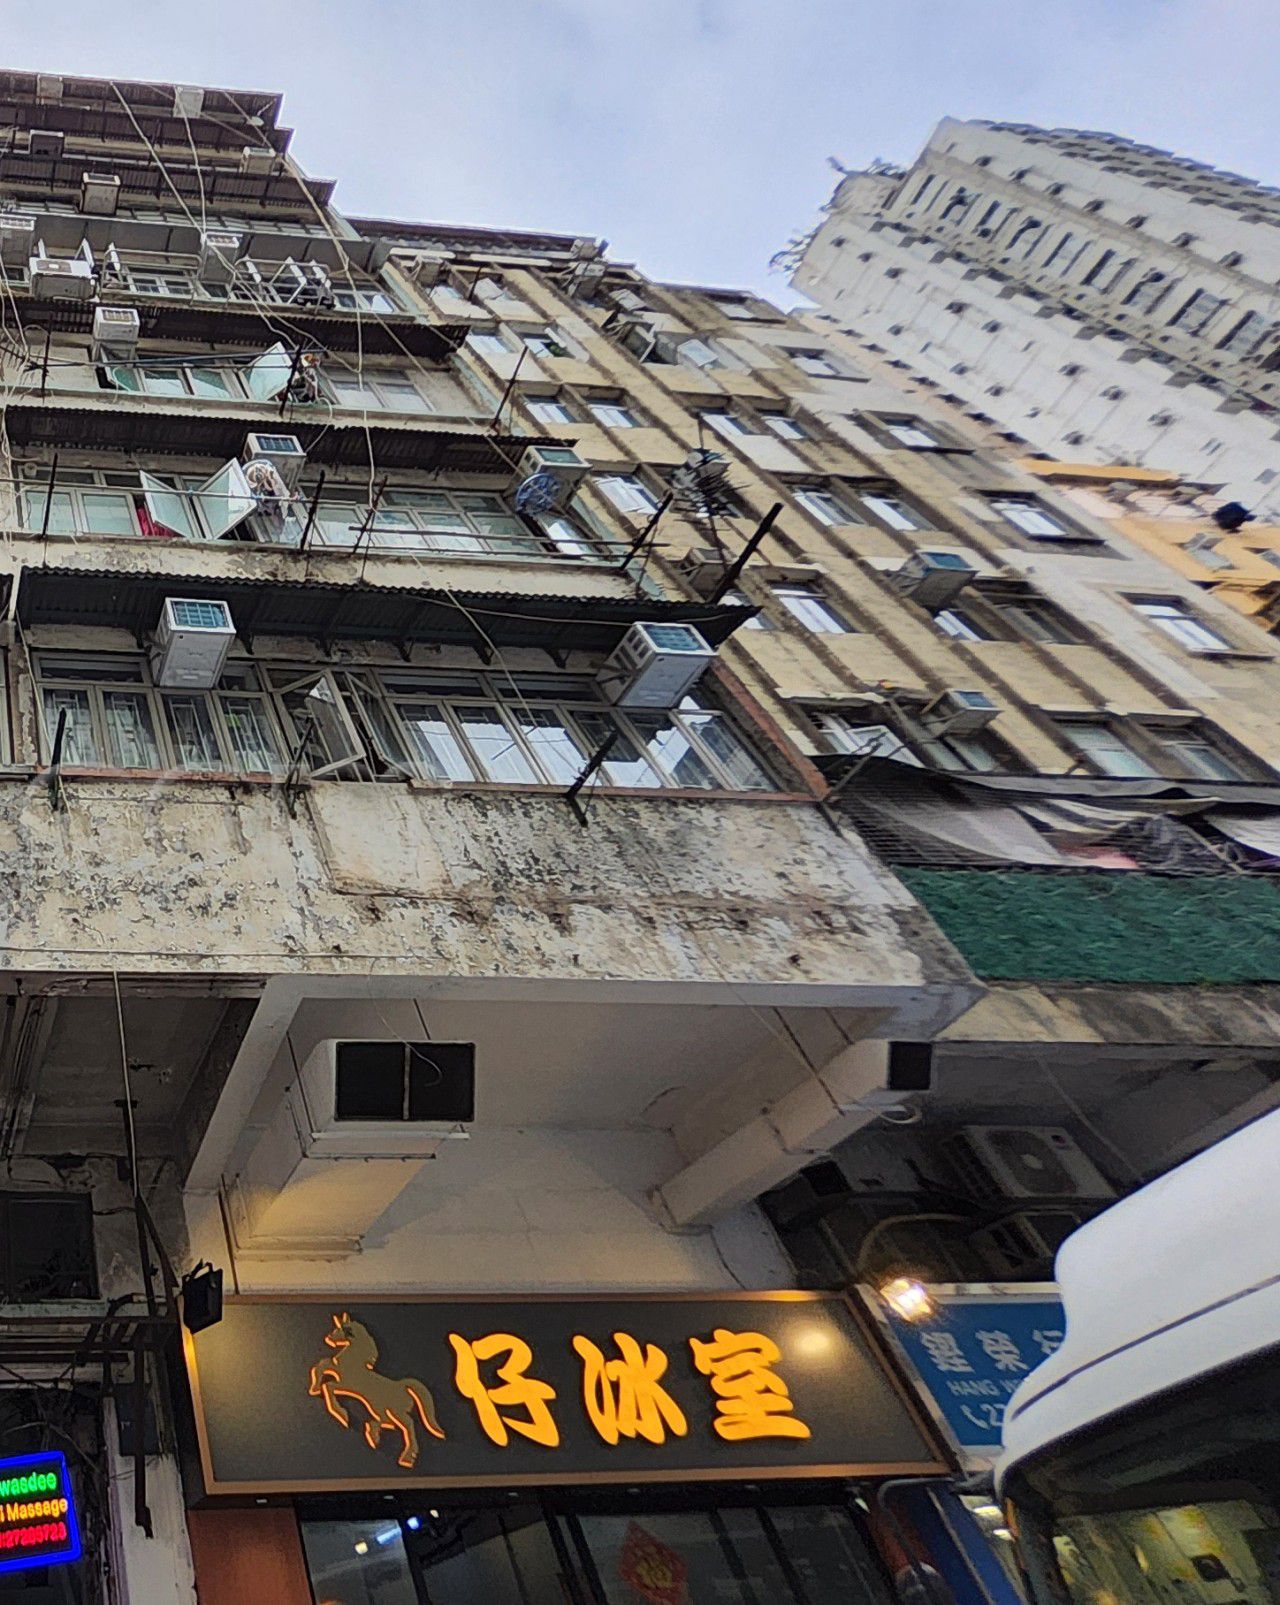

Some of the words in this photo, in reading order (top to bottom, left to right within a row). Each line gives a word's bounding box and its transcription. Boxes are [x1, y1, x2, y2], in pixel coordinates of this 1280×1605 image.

[449, 1328, 812, 1447] 仔冰室
[5, 1497, 68, 1522] Massage
